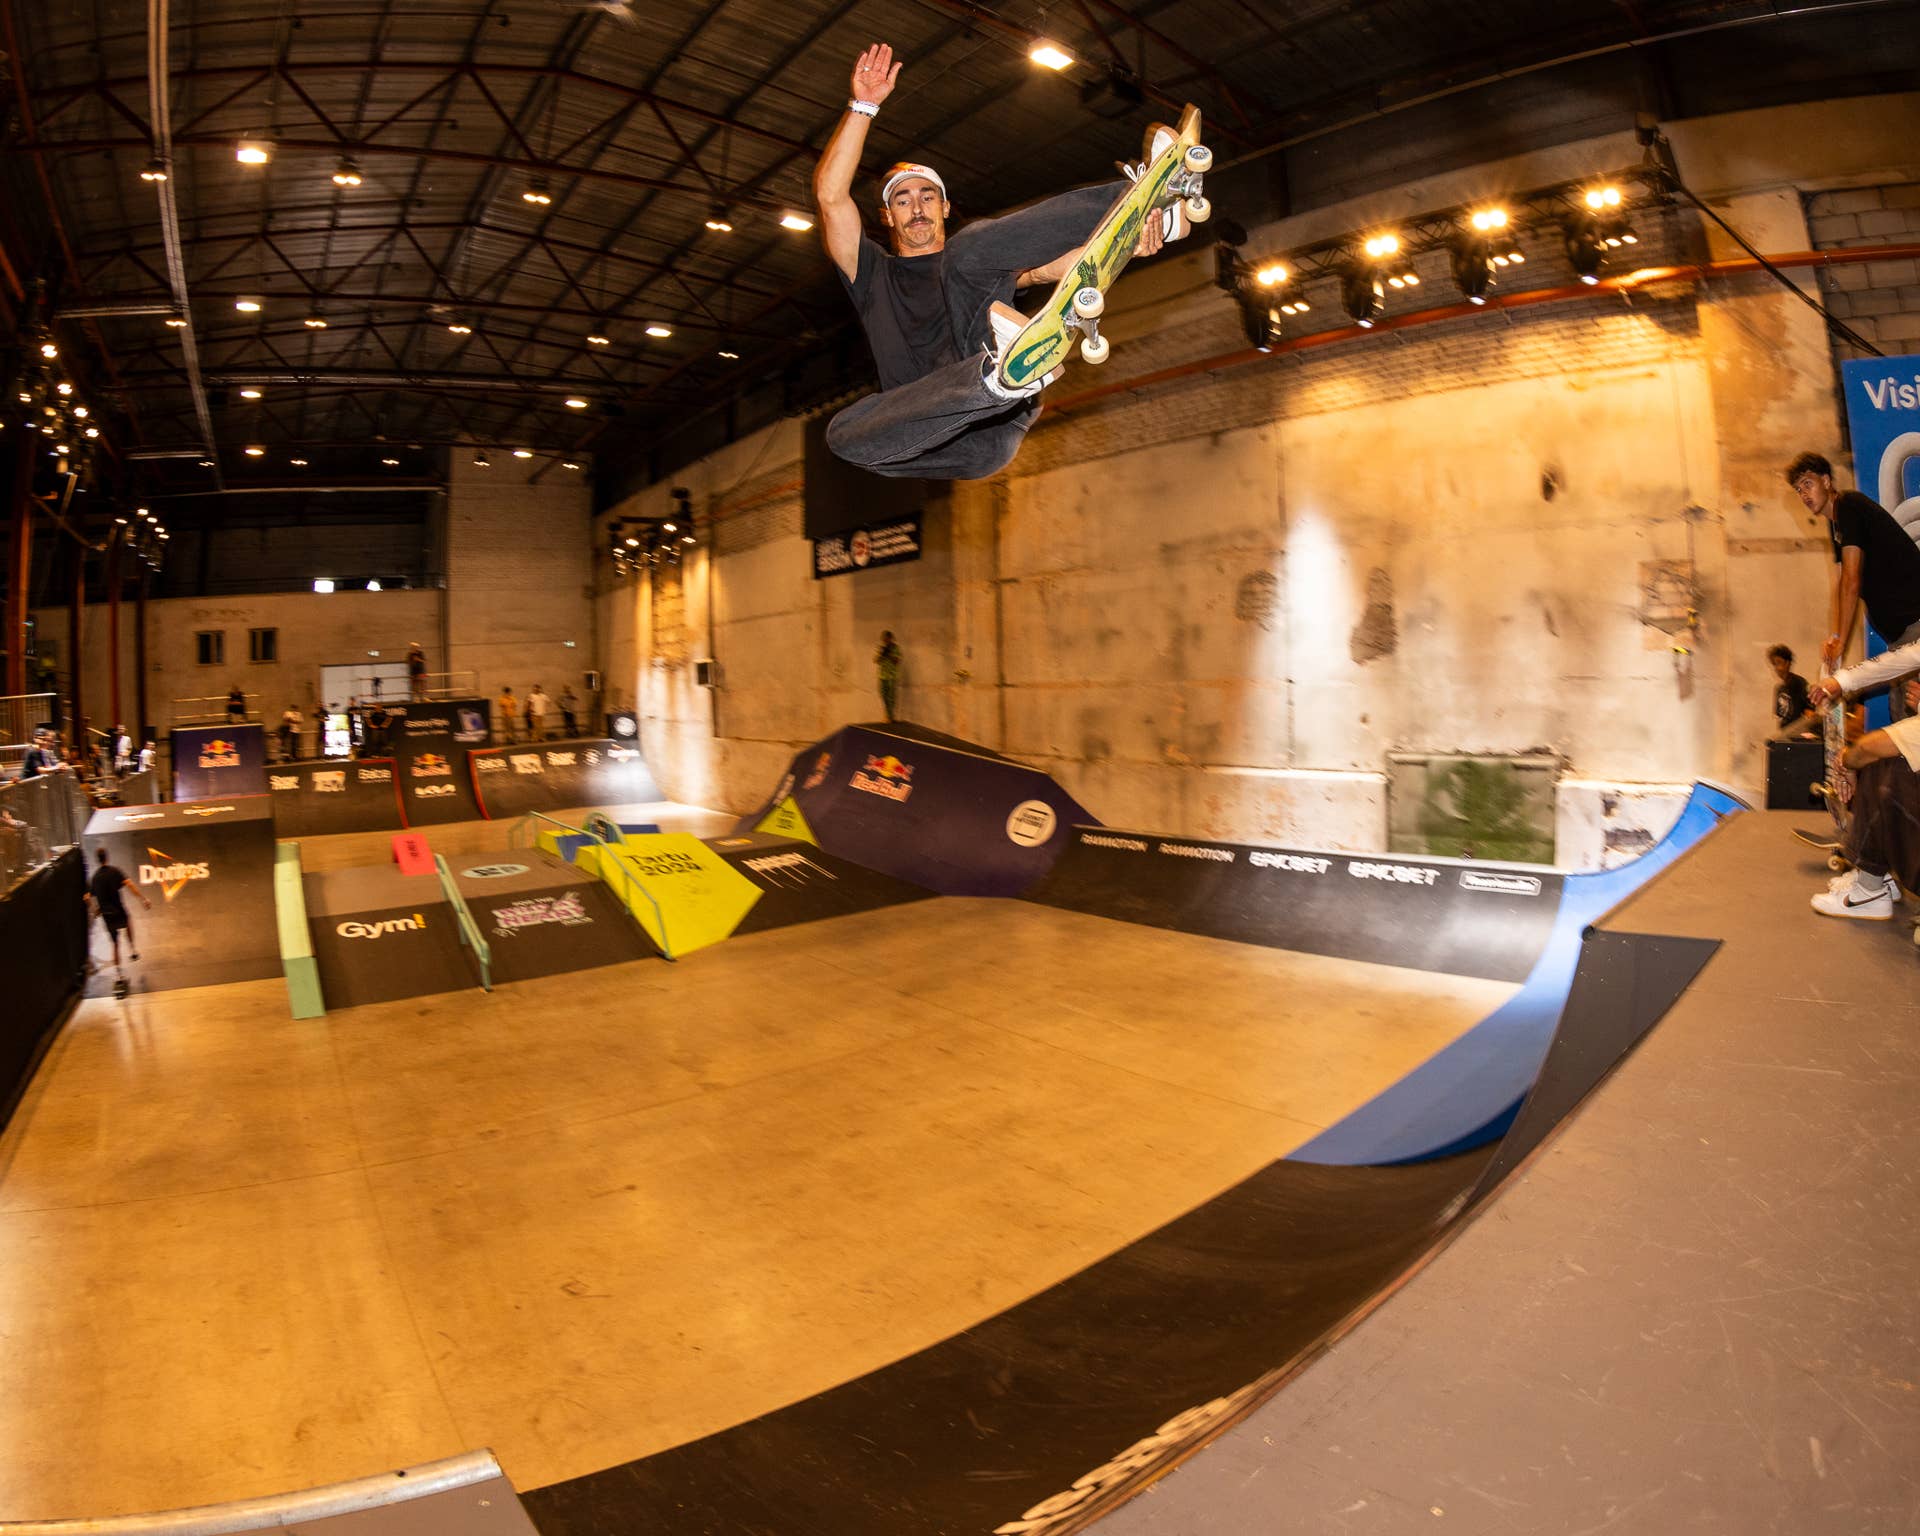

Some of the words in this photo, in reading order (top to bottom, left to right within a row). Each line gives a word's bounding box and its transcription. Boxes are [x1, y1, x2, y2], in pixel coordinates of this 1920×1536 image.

[624, 852, 694, 865] Tartu
[138, 861, 210, 885] Doritos
[638, 861, 704, 876] 2024
[336, 912, 426, 939] Gym!
